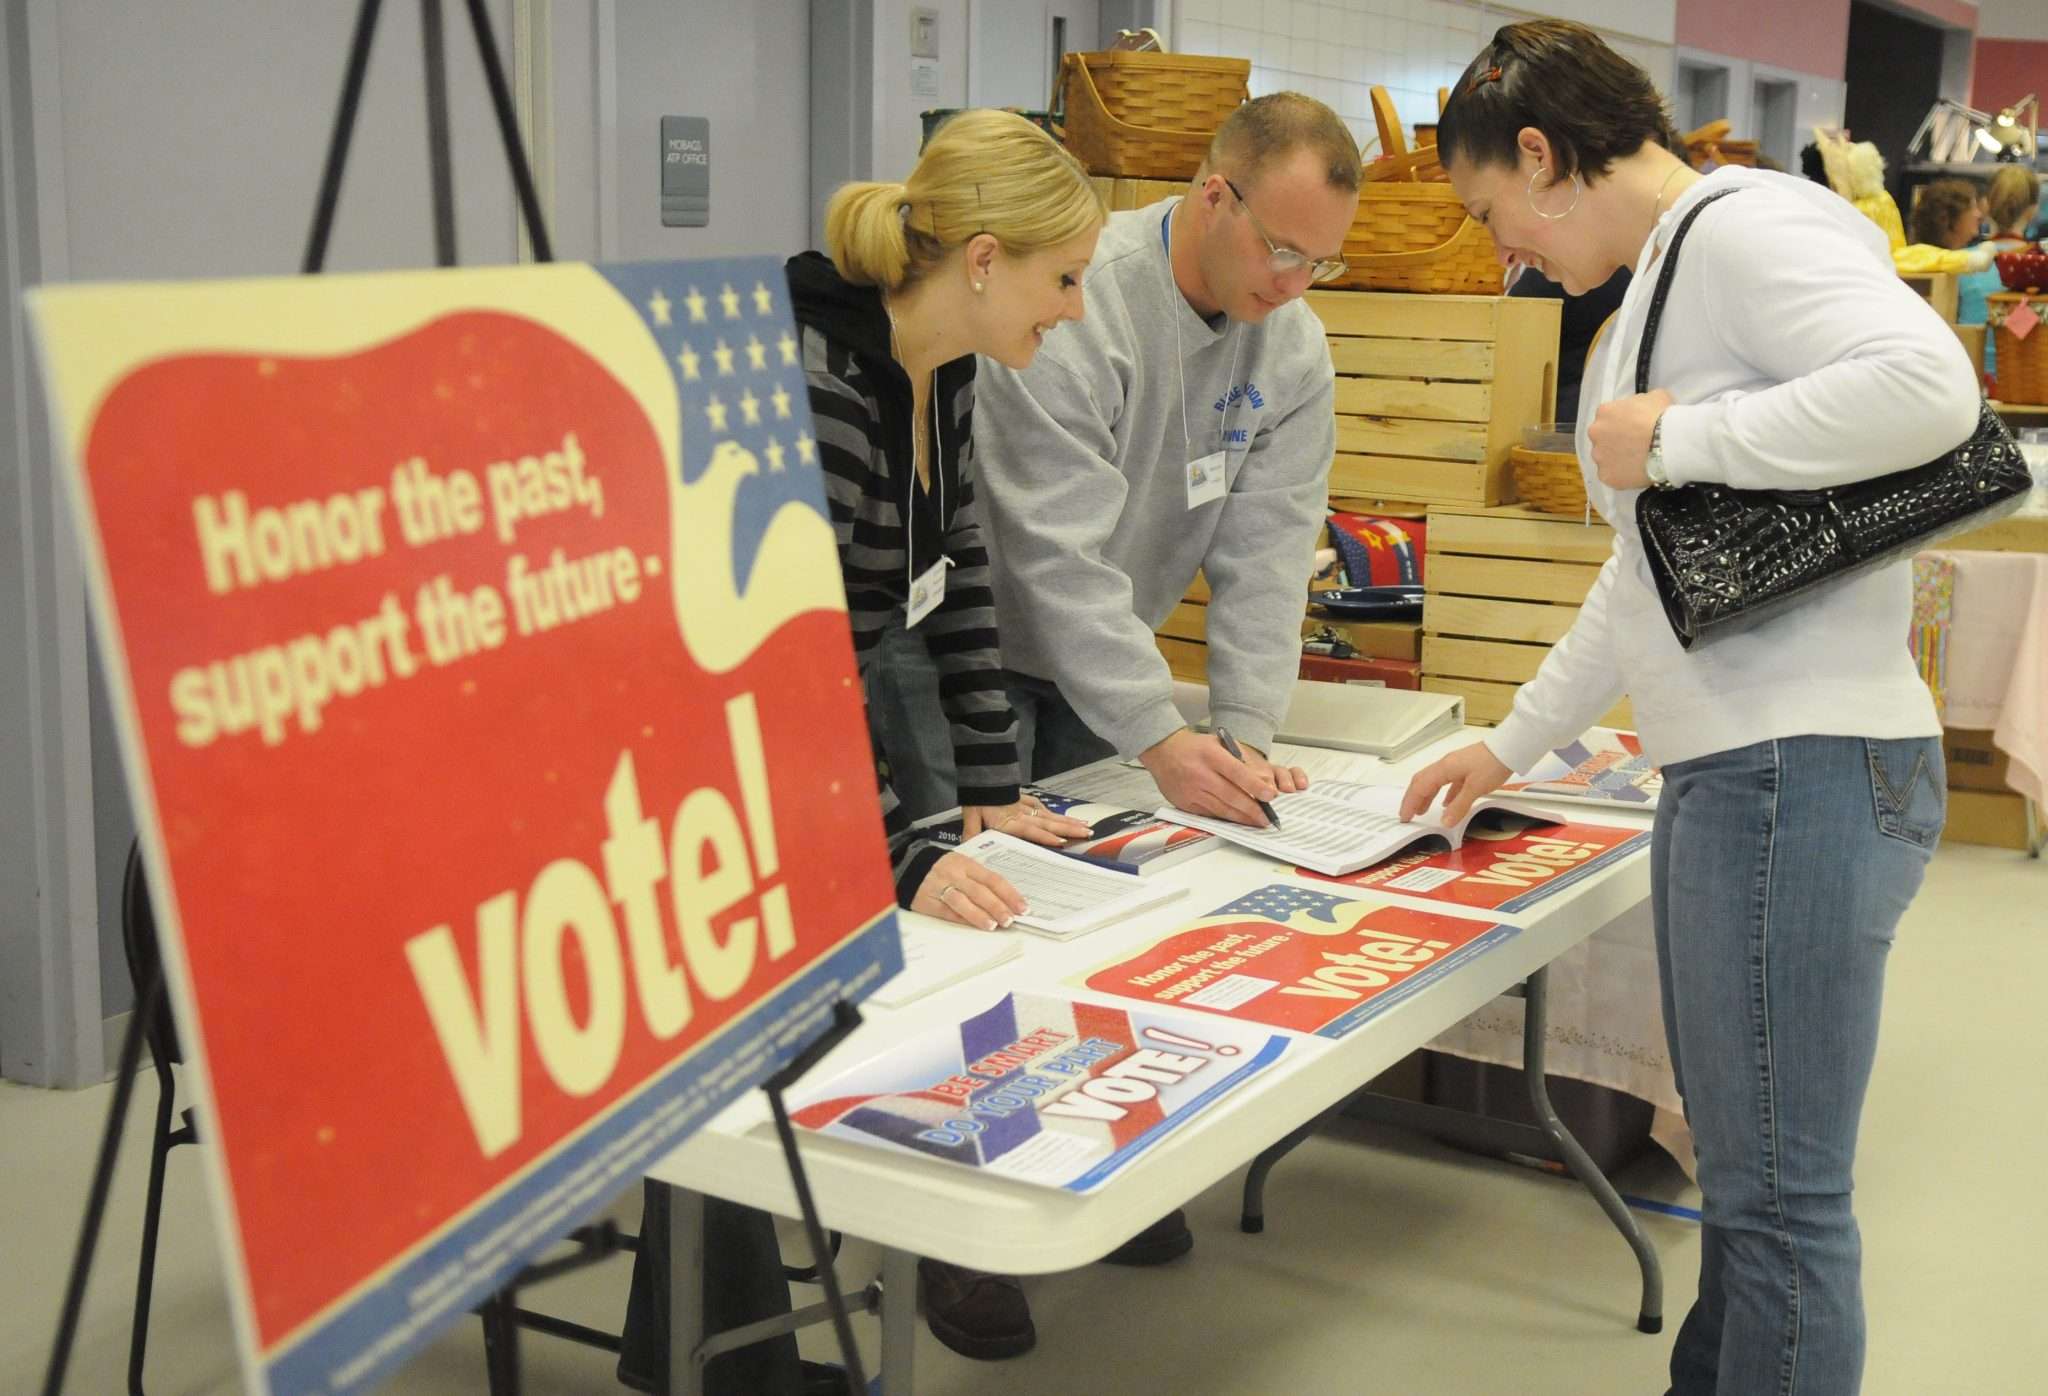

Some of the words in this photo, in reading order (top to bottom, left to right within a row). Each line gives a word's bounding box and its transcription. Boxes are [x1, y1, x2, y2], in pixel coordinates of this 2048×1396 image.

[682, 153, 707, 165] OFFICE
[193, 489, 386, 595] Honor
[392, 456, 485, 547] the
[490, 431, 604, 542] past,
[169, 592, 417, 748] support
[416, 570, 507, 666] the
[1460, 835, 1606, 887] vote!
[404, 691, 798, 1160] vote!
[1128, 961, 1188, 987] Honor
[1177, 949, 1216, 964] the
[1207, 933, 1257, 953] past,
[1153, 967, 1223, 1000] support
[1209, 955, 1248, 971] the
[1278, 929, 1452, 1000] vote!
[916, 1119, 988, 1146] DO
[973, 1074, 1066, 1118] YOUR
[1036, 1037, 1124, 1077] PART
[928, 1074, 990, 1098] BE
[968, 1026, 1074, 1078] SMART
